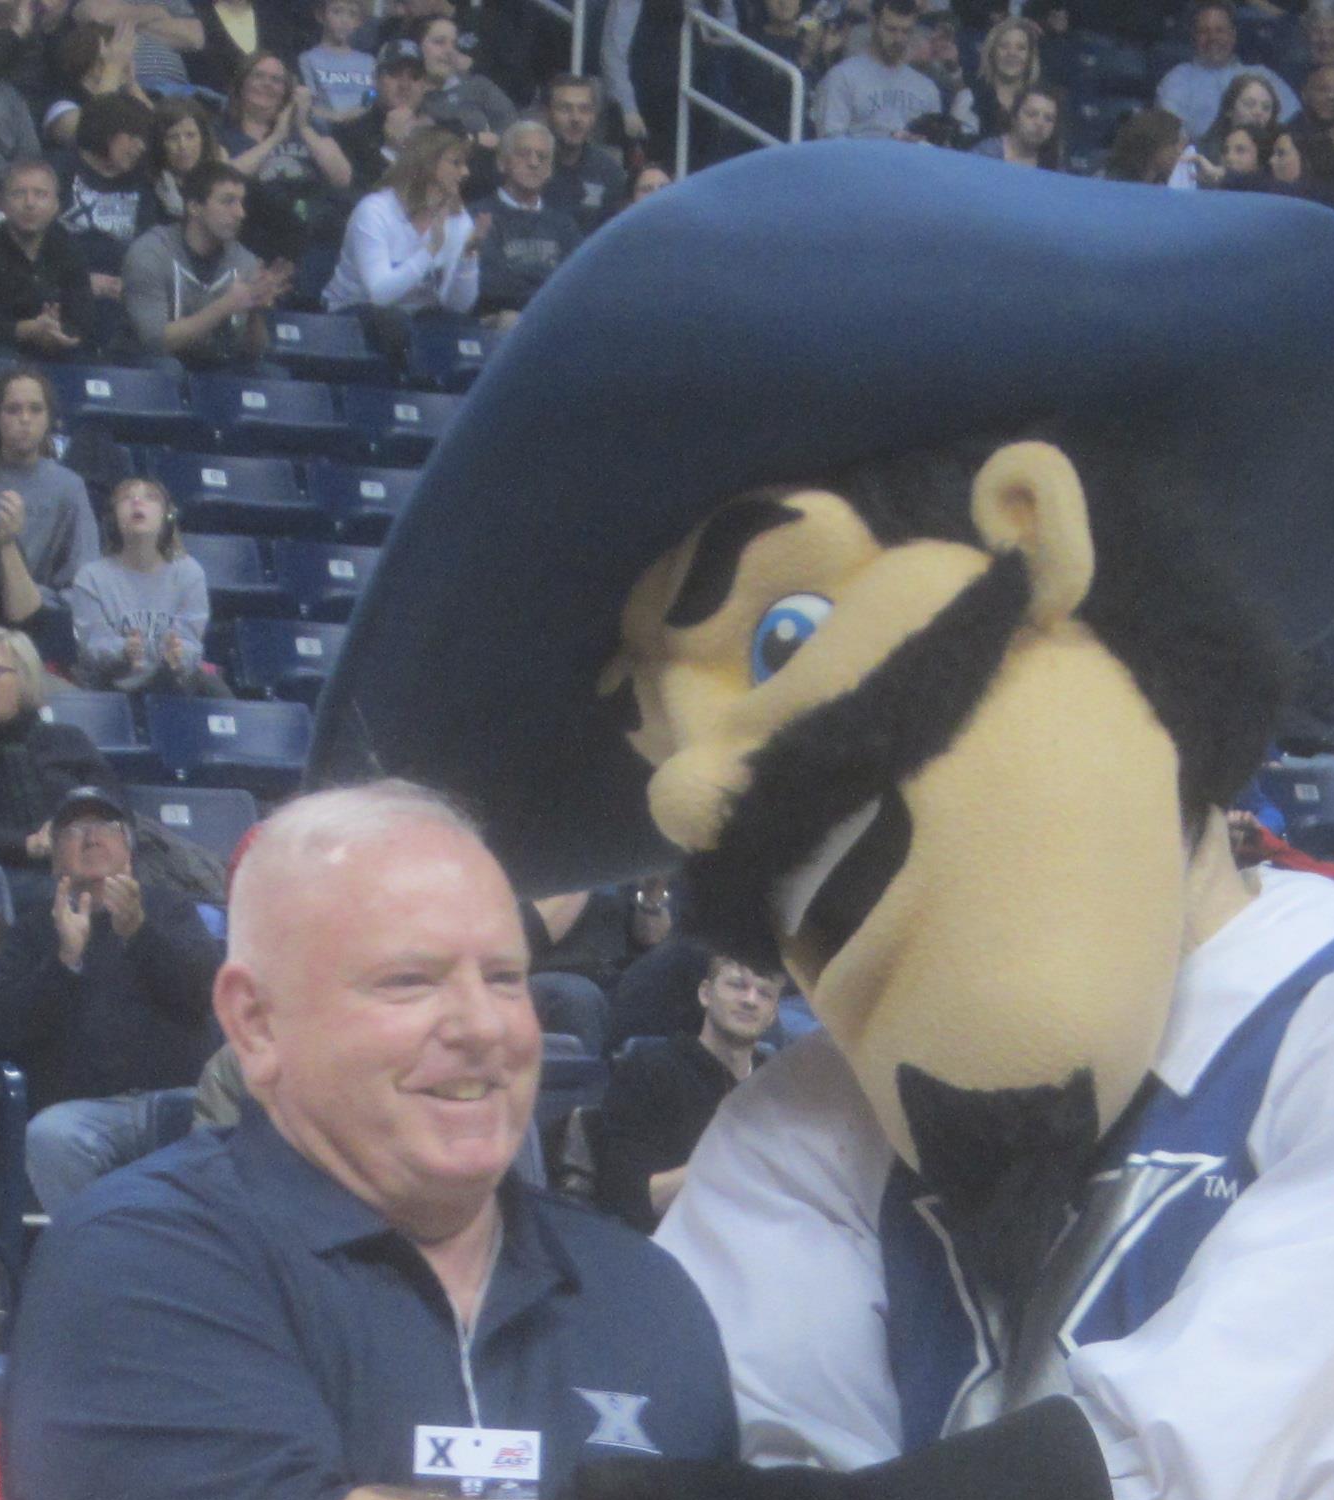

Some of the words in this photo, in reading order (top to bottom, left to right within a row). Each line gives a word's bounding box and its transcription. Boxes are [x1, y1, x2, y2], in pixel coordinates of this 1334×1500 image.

[1204, 1175, 1238, 1200] TM
[427, 1436, 456, 1468] X
[493, 1456, 533, 1467] EAST
